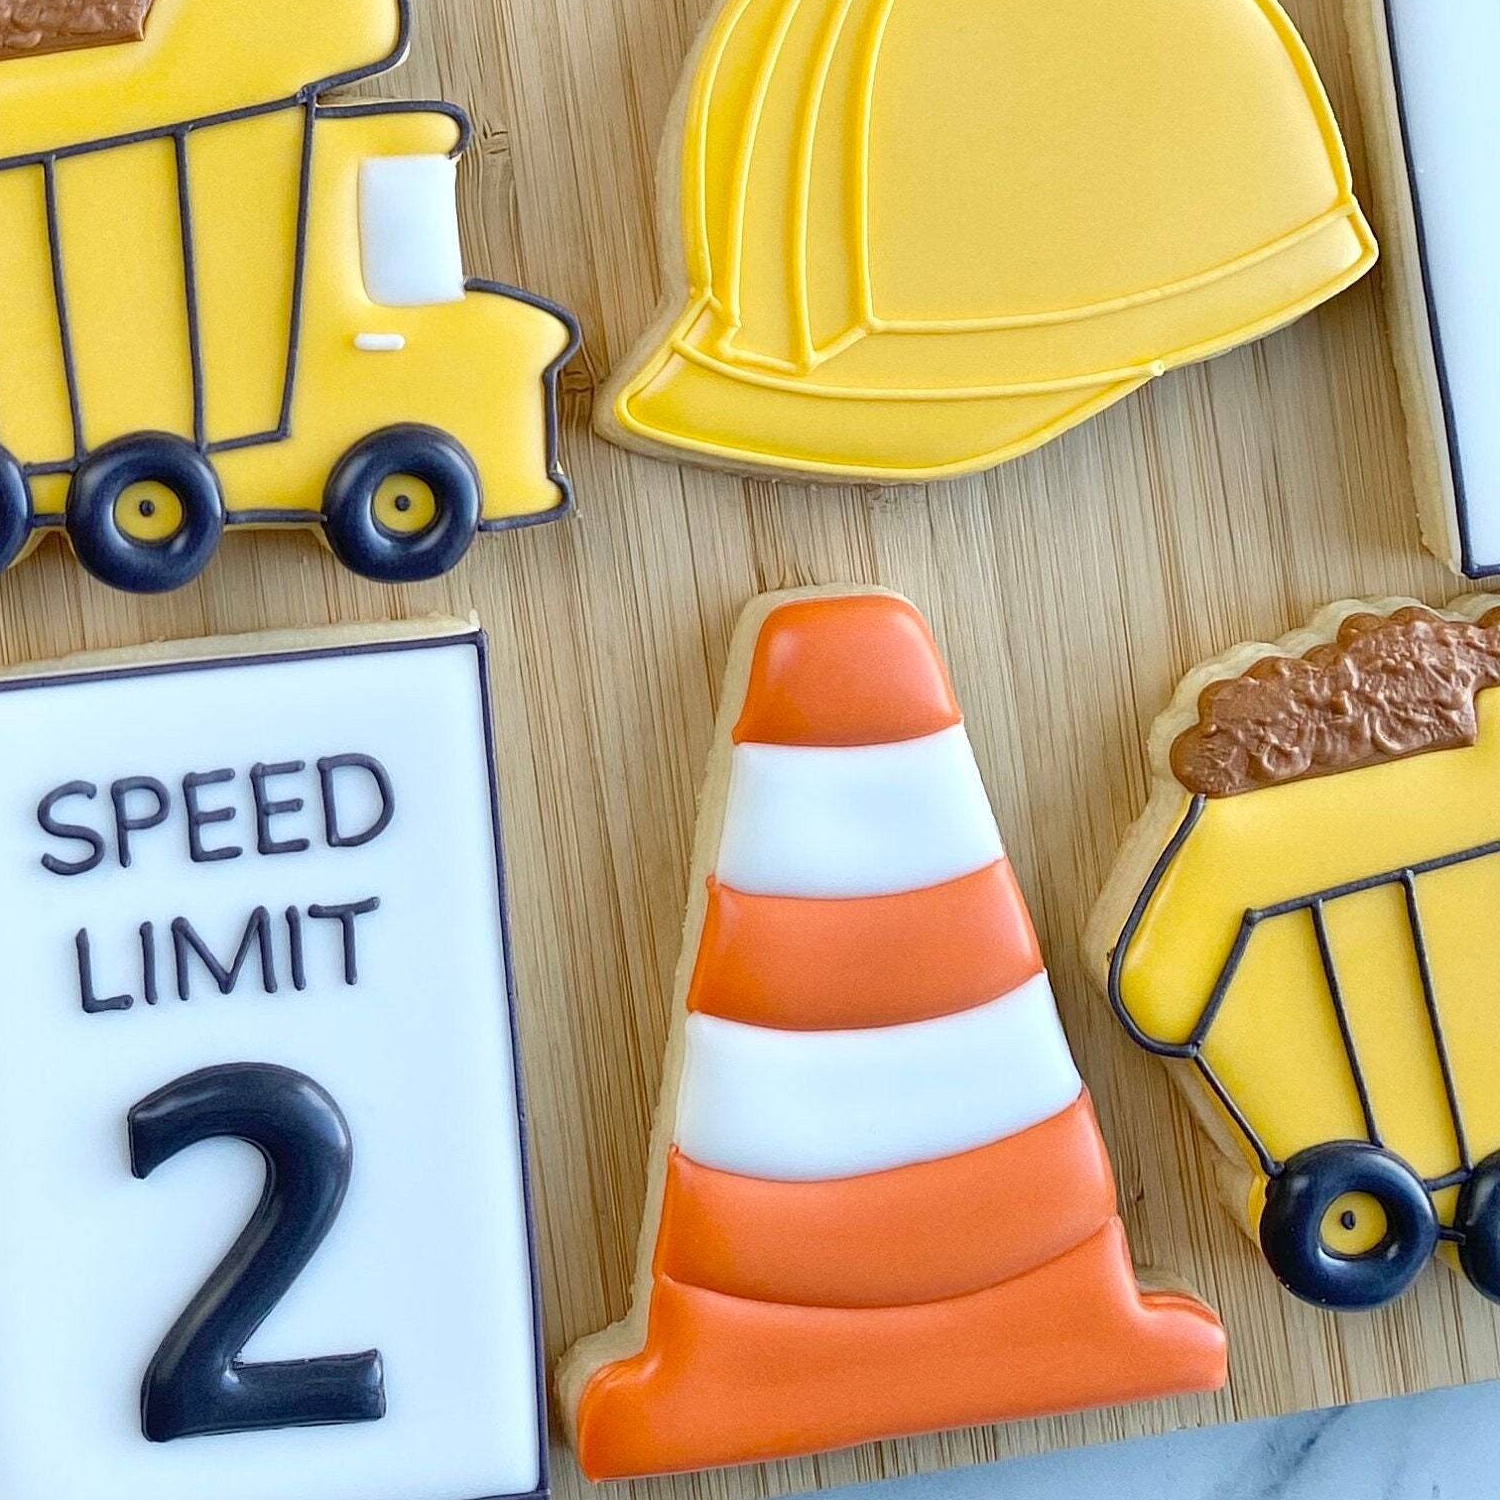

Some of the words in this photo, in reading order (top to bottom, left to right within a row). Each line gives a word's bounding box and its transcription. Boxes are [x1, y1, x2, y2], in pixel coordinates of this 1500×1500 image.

[36, 752, 395, 877] SPEED
[74, 896, 380, 1014] LIMIT
[126, 1061, 387, 1444] 2
